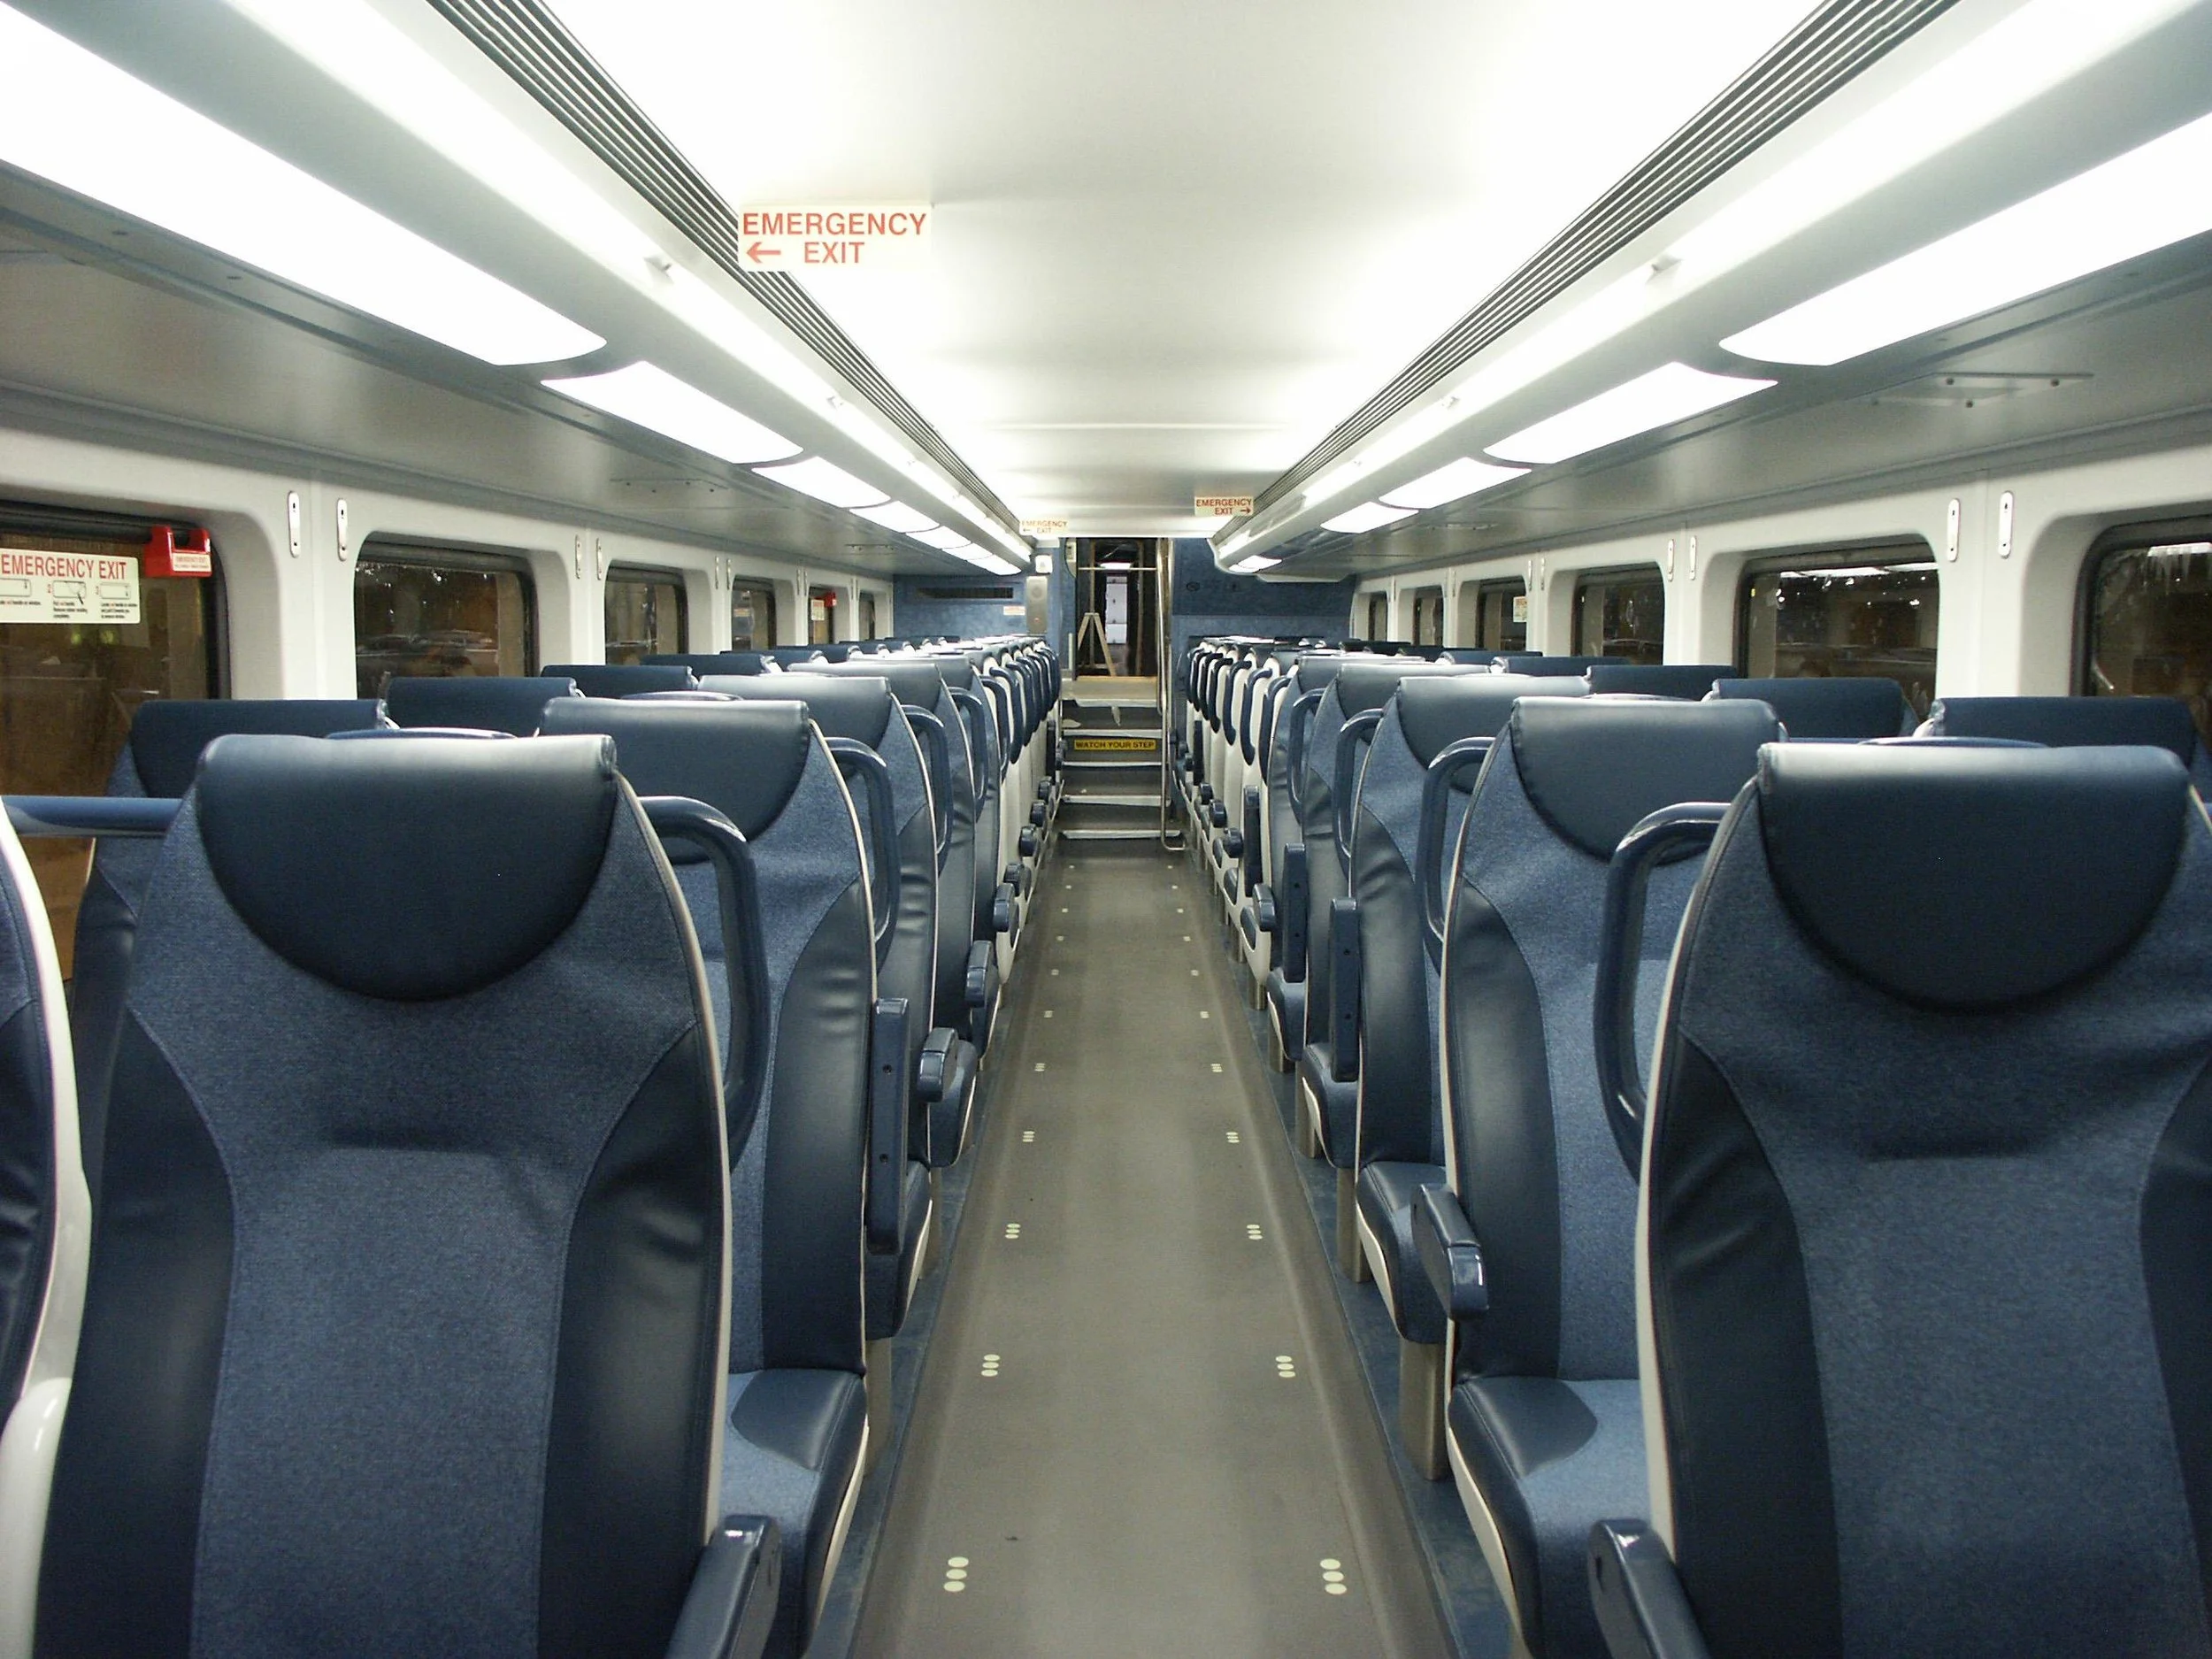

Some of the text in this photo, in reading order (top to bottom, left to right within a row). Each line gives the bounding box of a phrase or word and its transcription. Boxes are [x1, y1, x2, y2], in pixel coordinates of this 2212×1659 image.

[742, 212, 927, 235] EMERGENCY
[803, 242, 865, 264] EXIT
[1195, 498, 1252, 507] EMERGENCY
[1, 553, 127, 580] EMERGENCY EXIT
